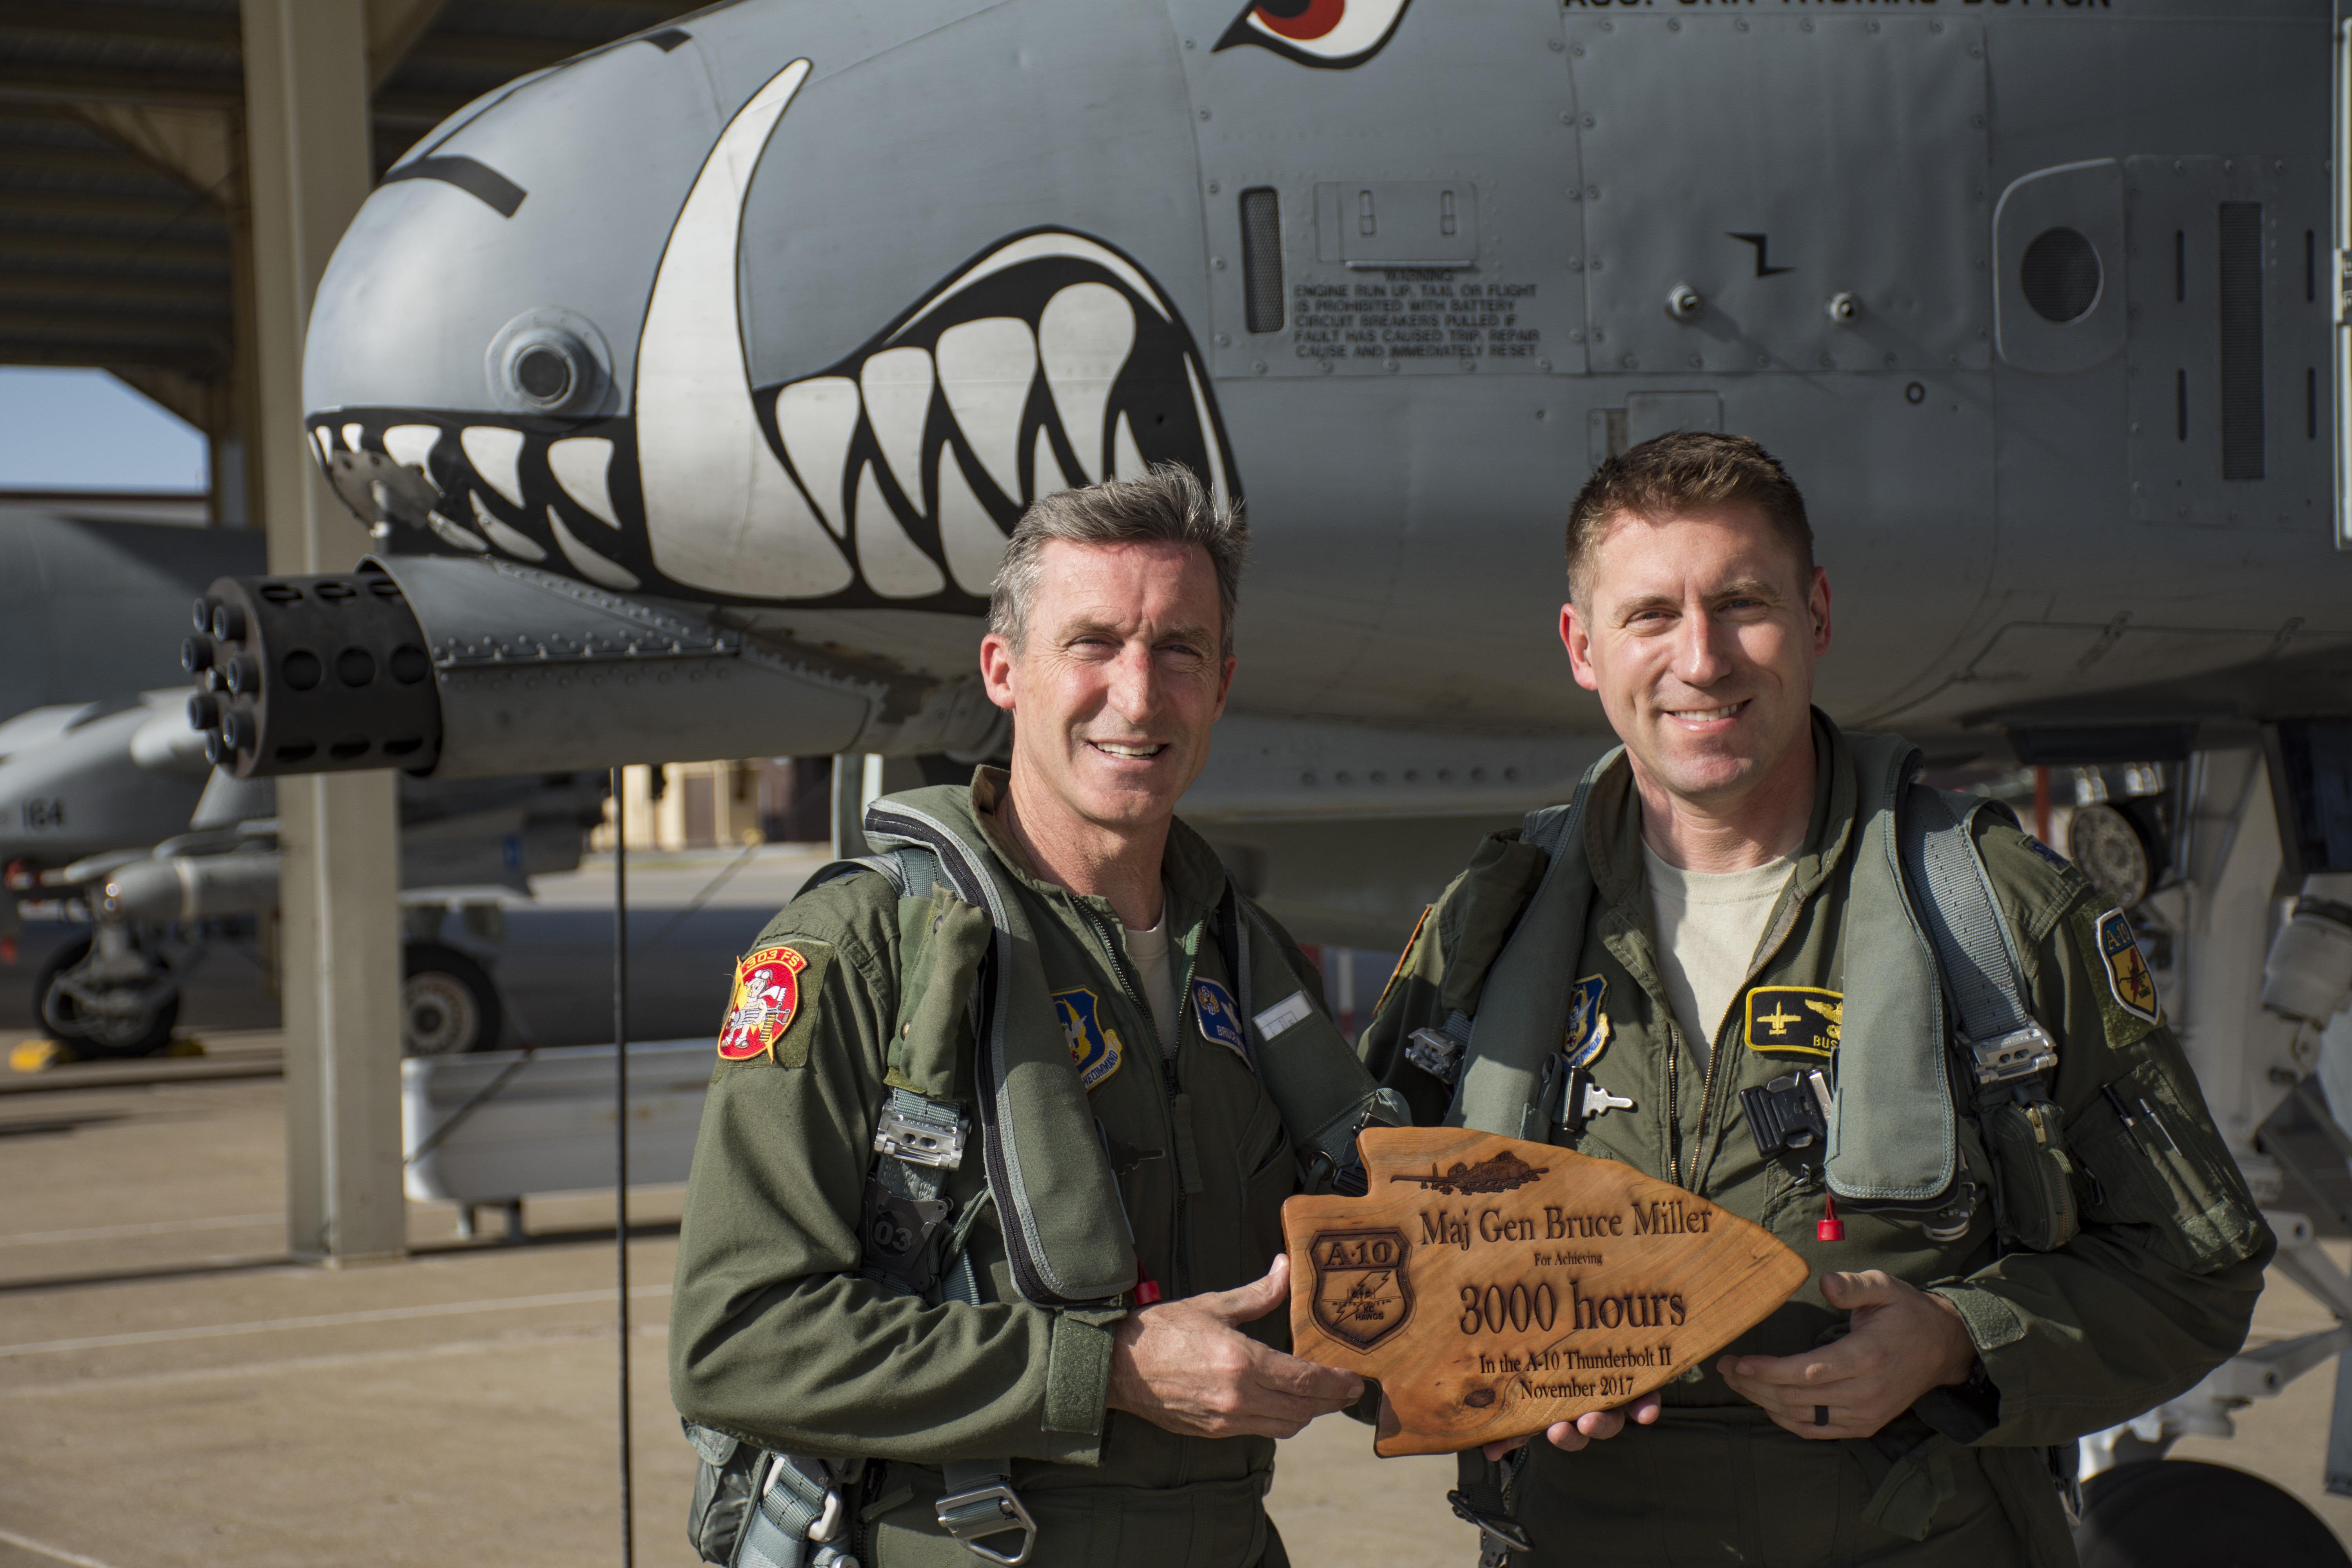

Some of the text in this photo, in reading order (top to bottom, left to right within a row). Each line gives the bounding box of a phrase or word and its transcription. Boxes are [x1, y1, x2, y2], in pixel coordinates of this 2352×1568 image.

[1294, 285, 1348, 298] ENGINE
[1355, 285, 1387, 297] RUN
[1461, 285, 1483, 297] OR
[1488, 284, 1537, 297] FLIGHT
[1294, 299, 1515, 312] IS PROHIBITED WITH BATTERY
[1294, 315, 1517, 328] CIRCUIT BREAKERS PULLED IF
[1294, 330, 1339, 343] FAULT
[1345, 330, 1377, 342] HAS
[1382, 329, 1443, 342] CAUSED
[1488, 329, 1540, 342] REPAIR
[1296, 344, 1535, 358] CAUSE AND IMMEDIATELY RESET
[746, 949, 800, 969] 303 FS
[1091, 1050, 1118, 1080] COMMAND
[874, 1221, 912, 1251] 03
[1419, 1201, 1712, 1251] Maj Gen Bruce Miller
[1534, 1252, 1602, 1266] For Achieving
[1460, 1280, 1686, 1335] 3000 hours
[1479, 1347, 1671, 1374] In the A-10 Thunderbolt II
[1521, 1377, 1634, 1400] November 2017
